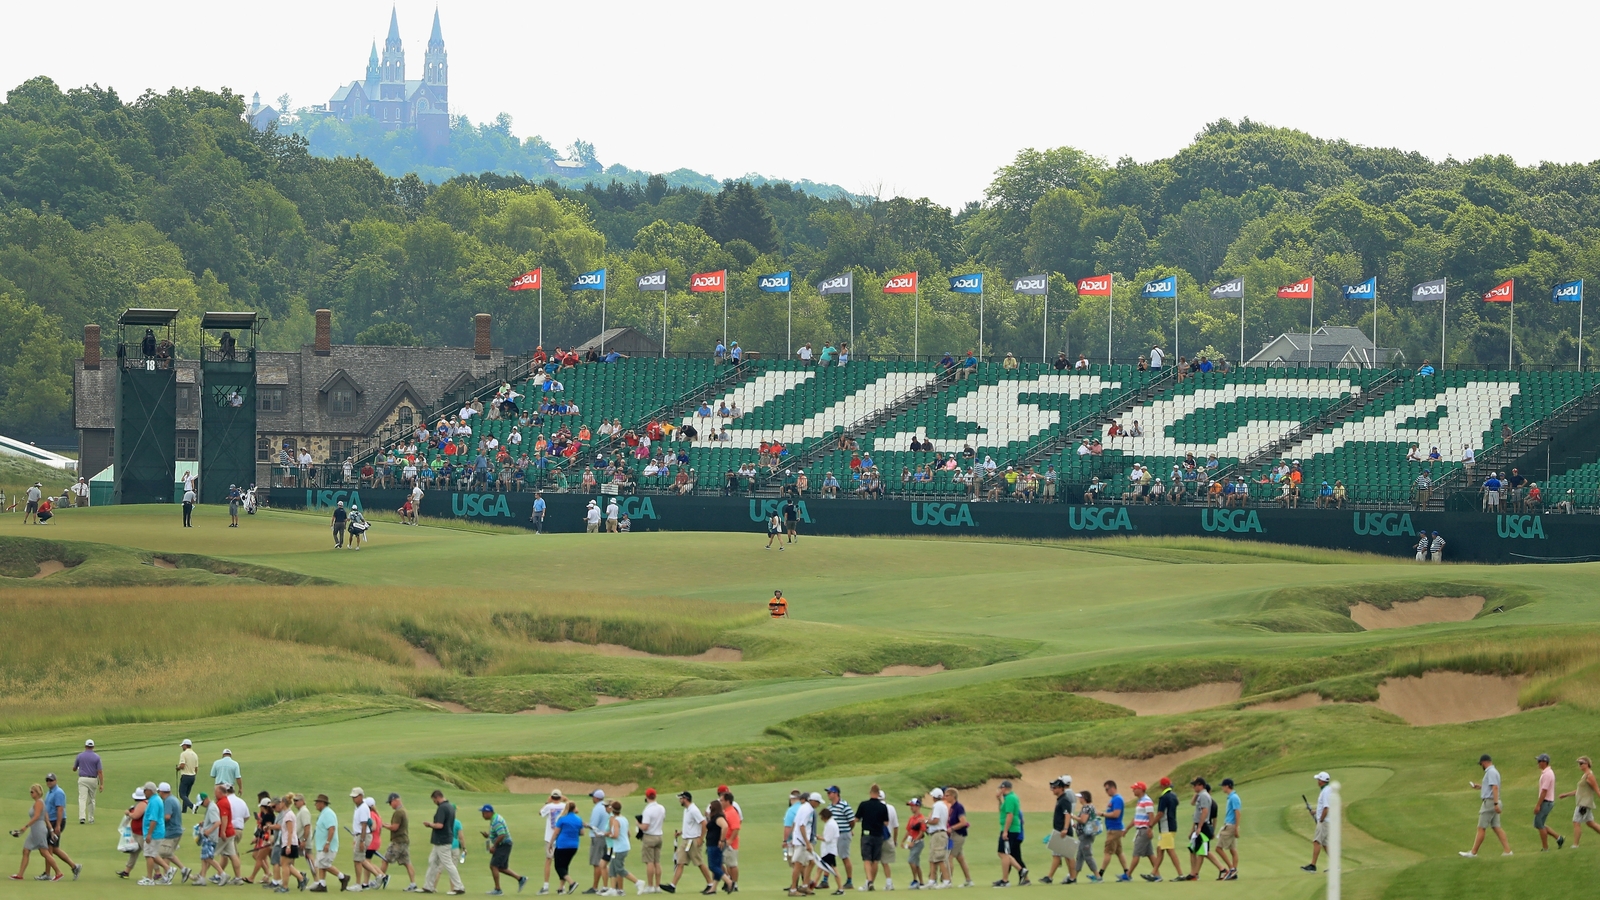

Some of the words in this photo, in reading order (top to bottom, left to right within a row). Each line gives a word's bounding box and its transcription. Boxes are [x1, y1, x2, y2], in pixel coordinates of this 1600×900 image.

[145, 360, 155, 371] 18
[306, 490, 363, 512] USGA
[451, 493, 511, 517] USGA
[911, 503, 974, 526] USGA
[1069, 507, 1132, 530] USGA
[1201, 508, 1262, 532] USGA
[1353, 512, 1415, 536] USGA
[1497, 515, 1545, 539] USGA
